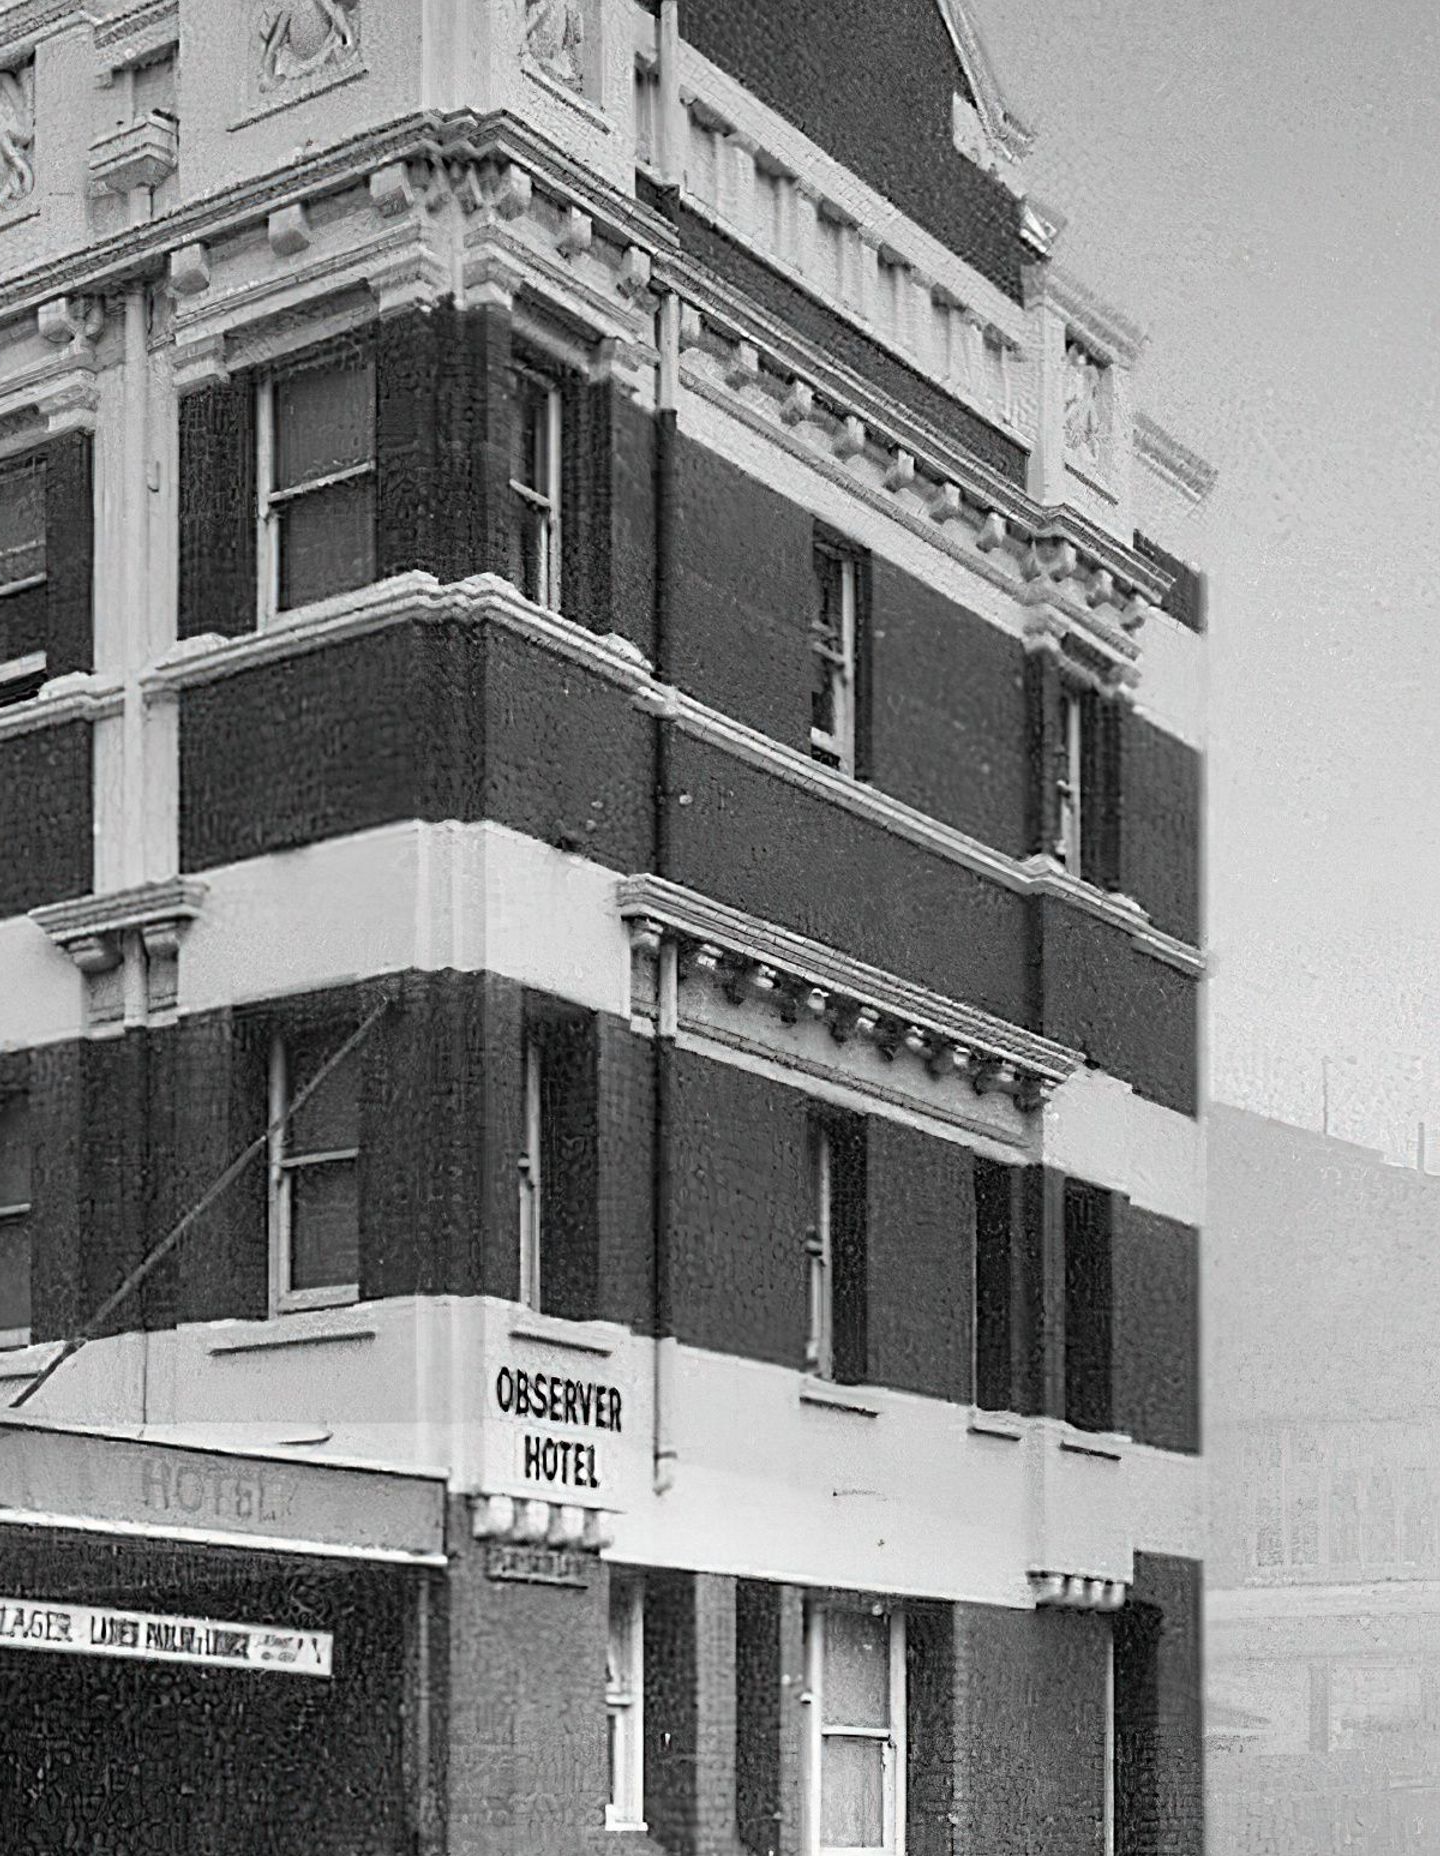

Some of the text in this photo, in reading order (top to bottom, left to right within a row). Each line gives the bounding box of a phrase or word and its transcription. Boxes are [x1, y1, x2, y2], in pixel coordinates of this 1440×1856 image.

[496, 1366, 622, 1432] OBSERVER
[141, 1458, 278, 1523] HOTEL
[524, 1434, 601, 1489] HOTEL
